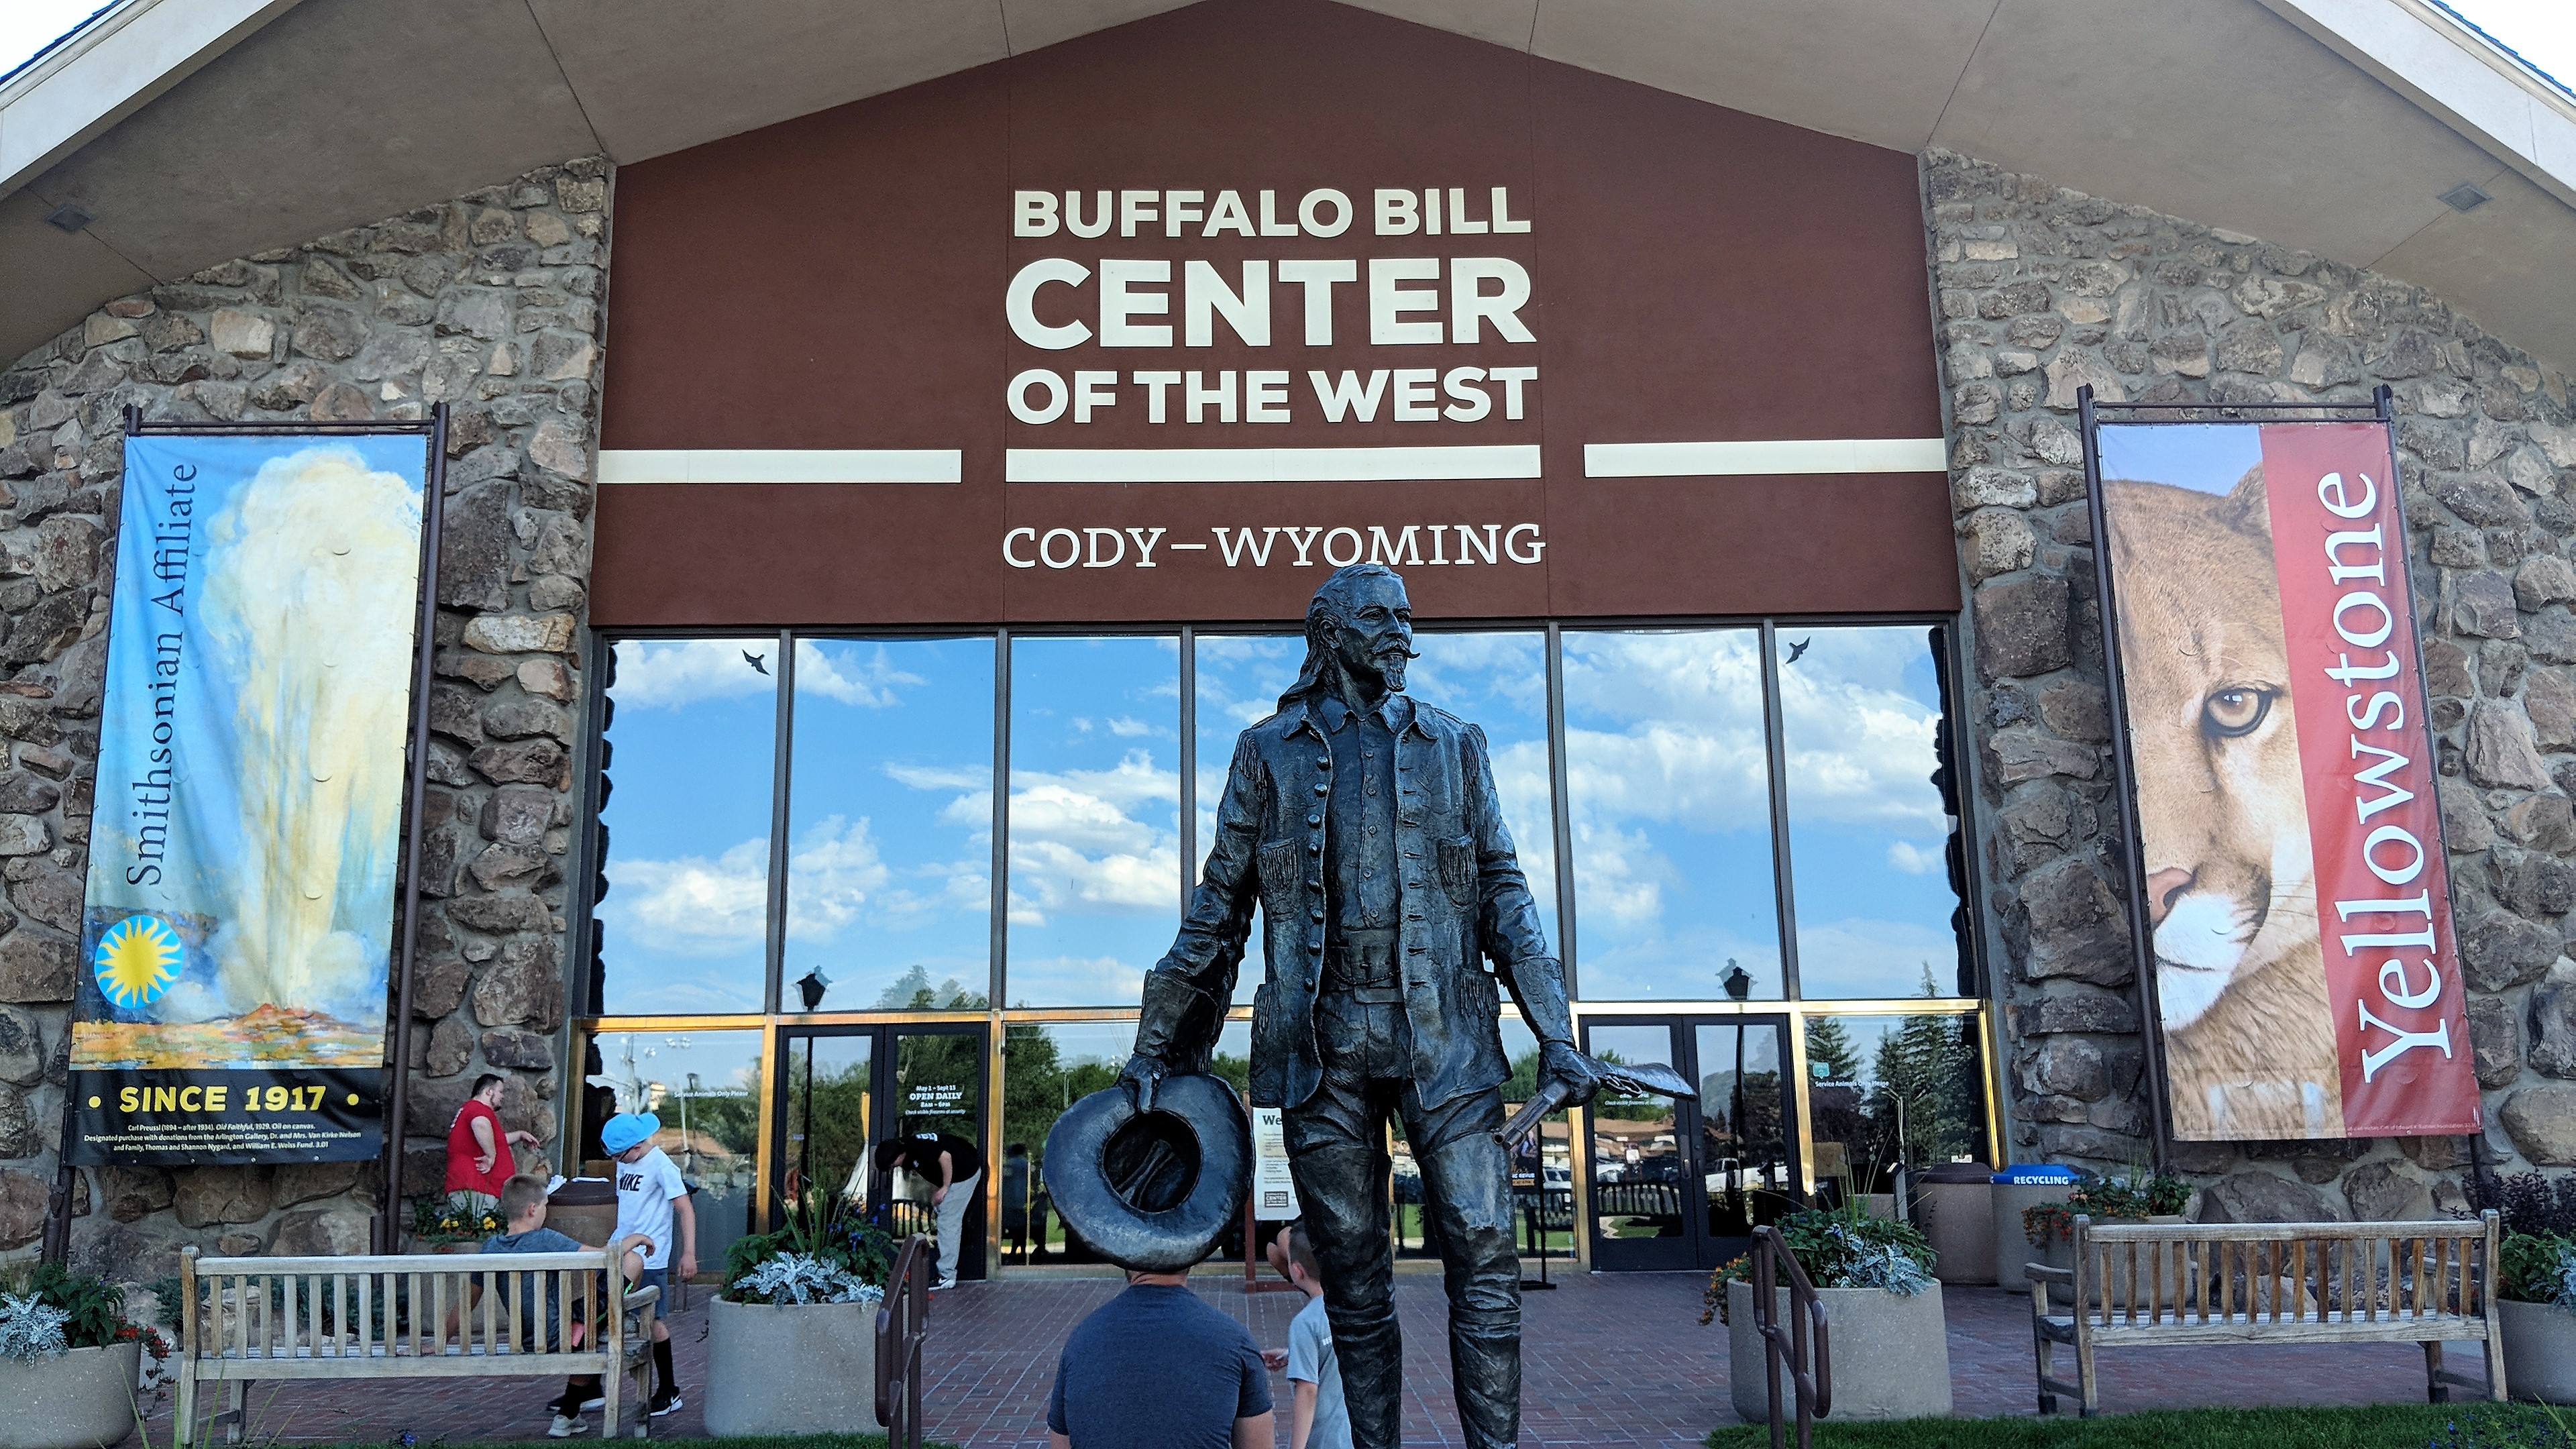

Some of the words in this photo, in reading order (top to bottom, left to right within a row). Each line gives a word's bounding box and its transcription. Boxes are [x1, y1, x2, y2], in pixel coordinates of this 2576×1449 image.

[1014, 188, 1354, 238] BUFFALO
[1375, 187, 1532, 235] BILL
[1005, 258, 1537, 350] CENTER
[1006, 368, 1118, 425] OF
[1133, 370, 1291, 424] THE
[1307, 366, 1538, 423] WEST
[150, 464, 197, 616] Affiliate
[126, 631, 182, 885] Smithsonian
[2317, 471, 2453, 1084] Yellowstone
[119, 1085, 228, 1113] SINCE
[245, 1085, 327, 1112] 1917
[716, 1091, 730, 1099] Only
[909, 1092, 934, 1101] OPEN
[936, 1091, 963, 1100] DAILY
[84, 1134, 118, 1143] Designated
[118, 1134, 143, 1142] purchase
[215, 1133, 244, 1142] Arlington
[2014, 1175, 2069, 1185] RECYCLING
